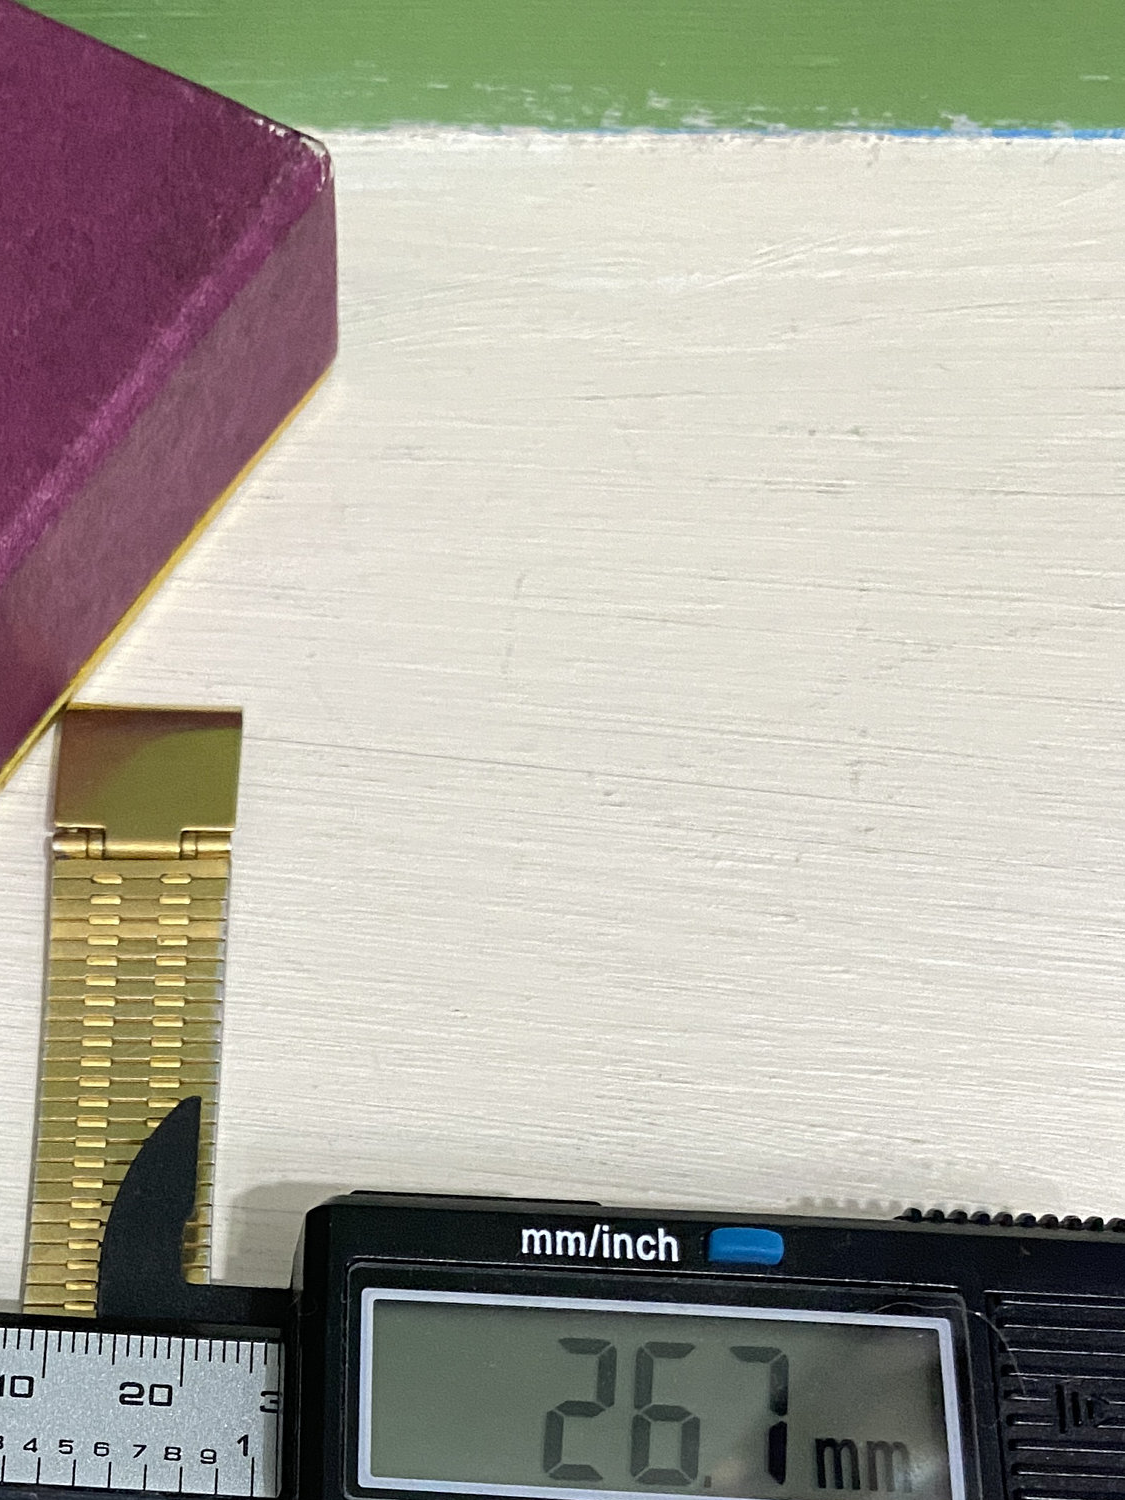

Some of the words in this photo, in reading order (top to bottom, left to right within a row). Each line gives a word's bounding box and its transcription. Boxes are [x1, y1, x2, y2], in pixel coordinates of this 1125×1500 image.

[521, 1224, 679, 1262] mm/inch
[118, 1381, 173, 1407] 20
[259, 1390, 279, 1414] 3
[542, 1337, 789, 1487] 26.7
[814, 1437, 912, 1493] mm
[22, 1437, 38, 1453] 4
[58, 1439, 75, 1455] 5
[93, 1441, 110, 1458] 6
[132, 1444, 147, 1459] 7
[163, 1446, 182, 1462] 8
[200, 1448, 217, 1465] 9
[236, 1434, 249, 1457] 1
